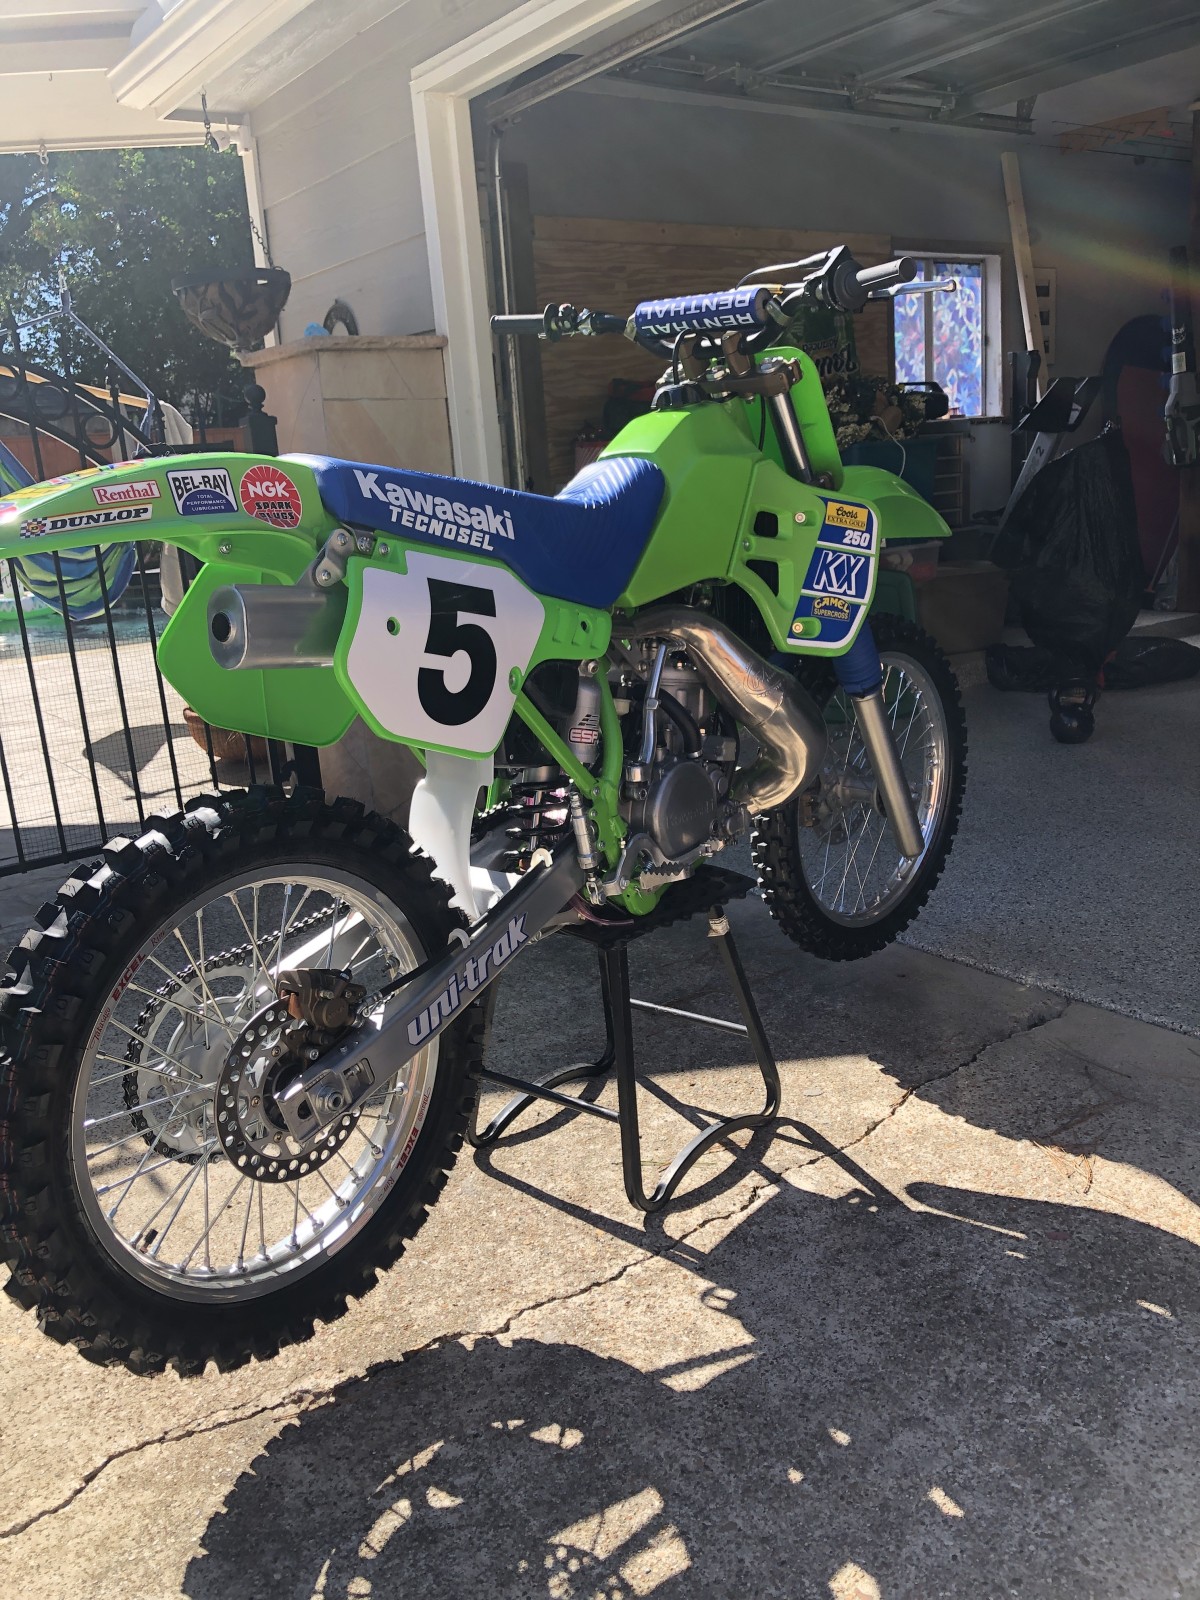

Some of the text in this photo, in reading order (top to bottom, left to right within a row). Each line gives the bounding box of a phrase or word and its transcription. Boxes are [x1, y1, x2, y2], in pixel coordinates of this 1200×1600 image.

[641, 292, 751, 320] RENTHAL
[642, 312, 755, 336] RENTHAL
[96, 483, 155, 503] Renthal
[171, 474, 230, 502] BEL-RAY
[247, 481, 290, 498] NGK
[255, 501, 293, 510] SPARK
[258, 511, 295, 520] PLUGS
[352, 469, 516, 541] Kawasaki
[836, 506, 858, 519] Coors
[49, 507, 149, 531] DUNLOP
[388, 505, 494, 551] TECNOSEL
[827, 515, 866, 528] EXTRA GOLD
[843, 530, 870, 547] 250
[813, 550, 865, 595] KX
[813, 608, 849, 620] SUPERCROSS
[814, 597, 850, 613] CAMEL
[417, 577, 498, 727] 5
[111, 953, 147, 1002] EXCEL
[407, 912, 529, 1046] uni-trak
[395, 1126, 420, 1170] EXCEL
